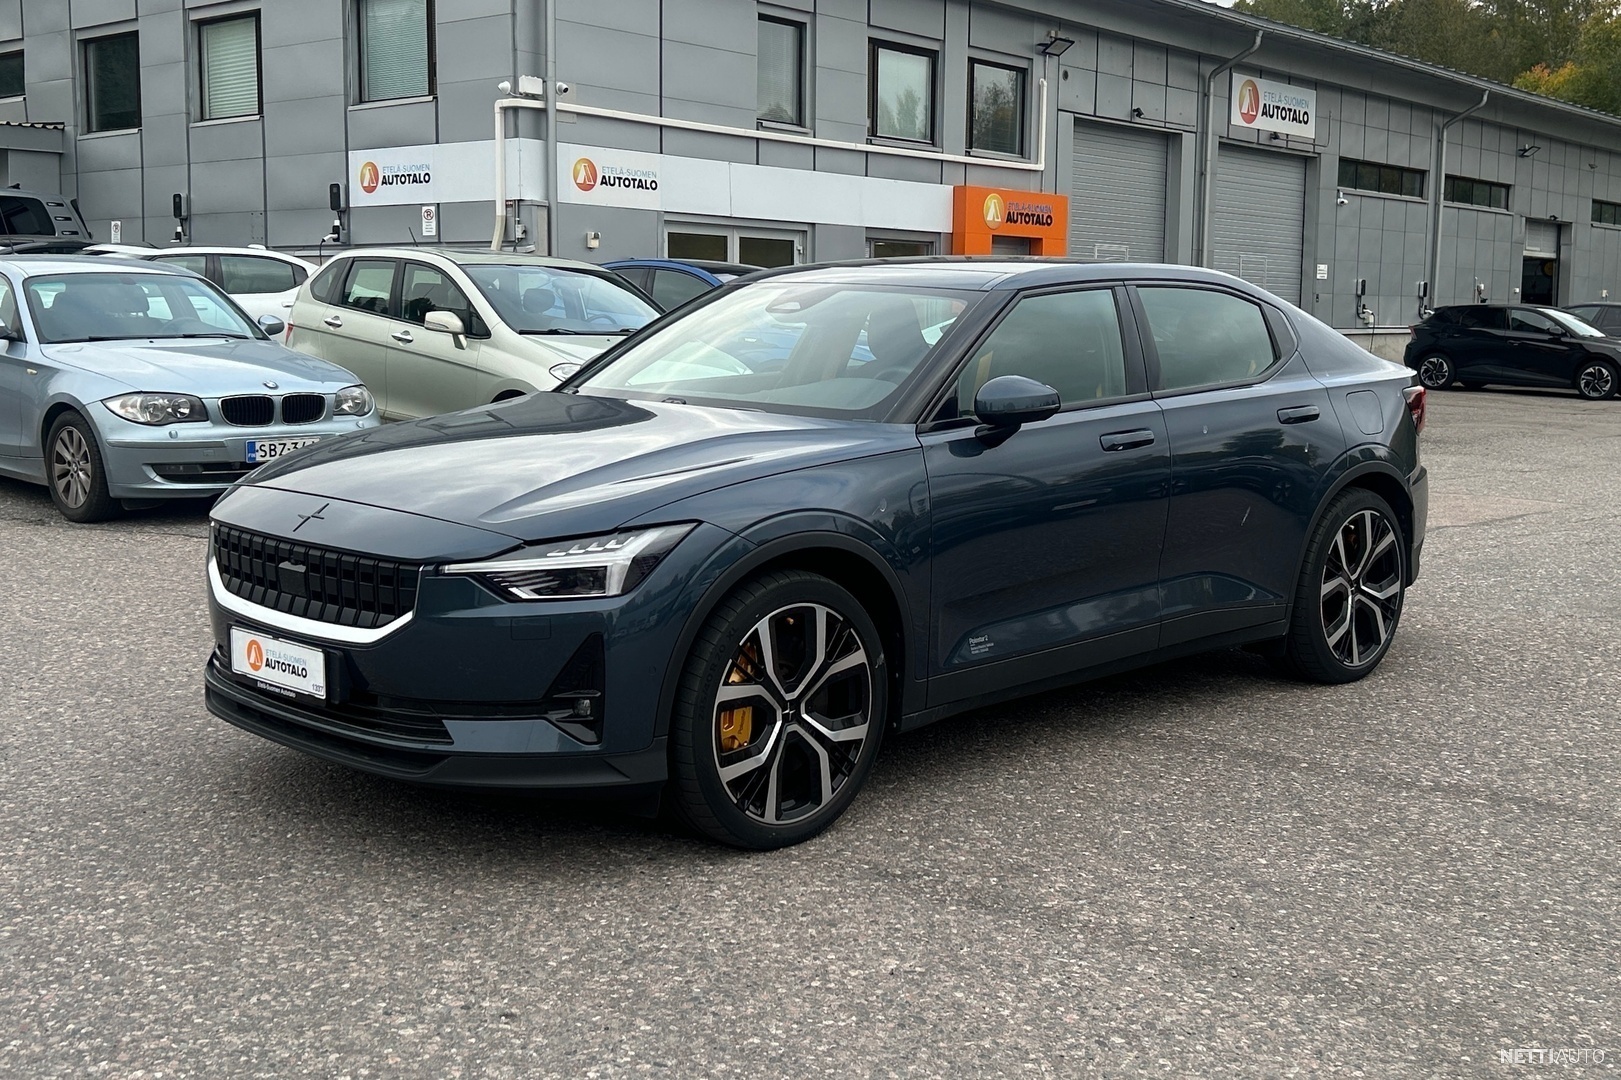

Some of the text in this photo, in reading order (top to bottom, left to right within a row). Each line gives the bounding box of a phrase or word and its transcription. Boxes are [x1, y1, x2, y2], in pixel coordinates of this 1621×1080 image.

[1263, 91, 1309, 109] ETELÄ-SUOMEN
[1261, 103, 1309, 125] AUTOTALO
[381, 172, 431, 186] AUTOTALO
[601, 166, 657, 179] ETELÄ-SUOMEN
[600, 175, 658, 191] AUTOTALO
[1005, 211, 1053, 226] AUTOTALO
[266, 648, 307, 666] ETELÄ-SUOMEN
[265, 657, 308, 679] AUTOTALO
